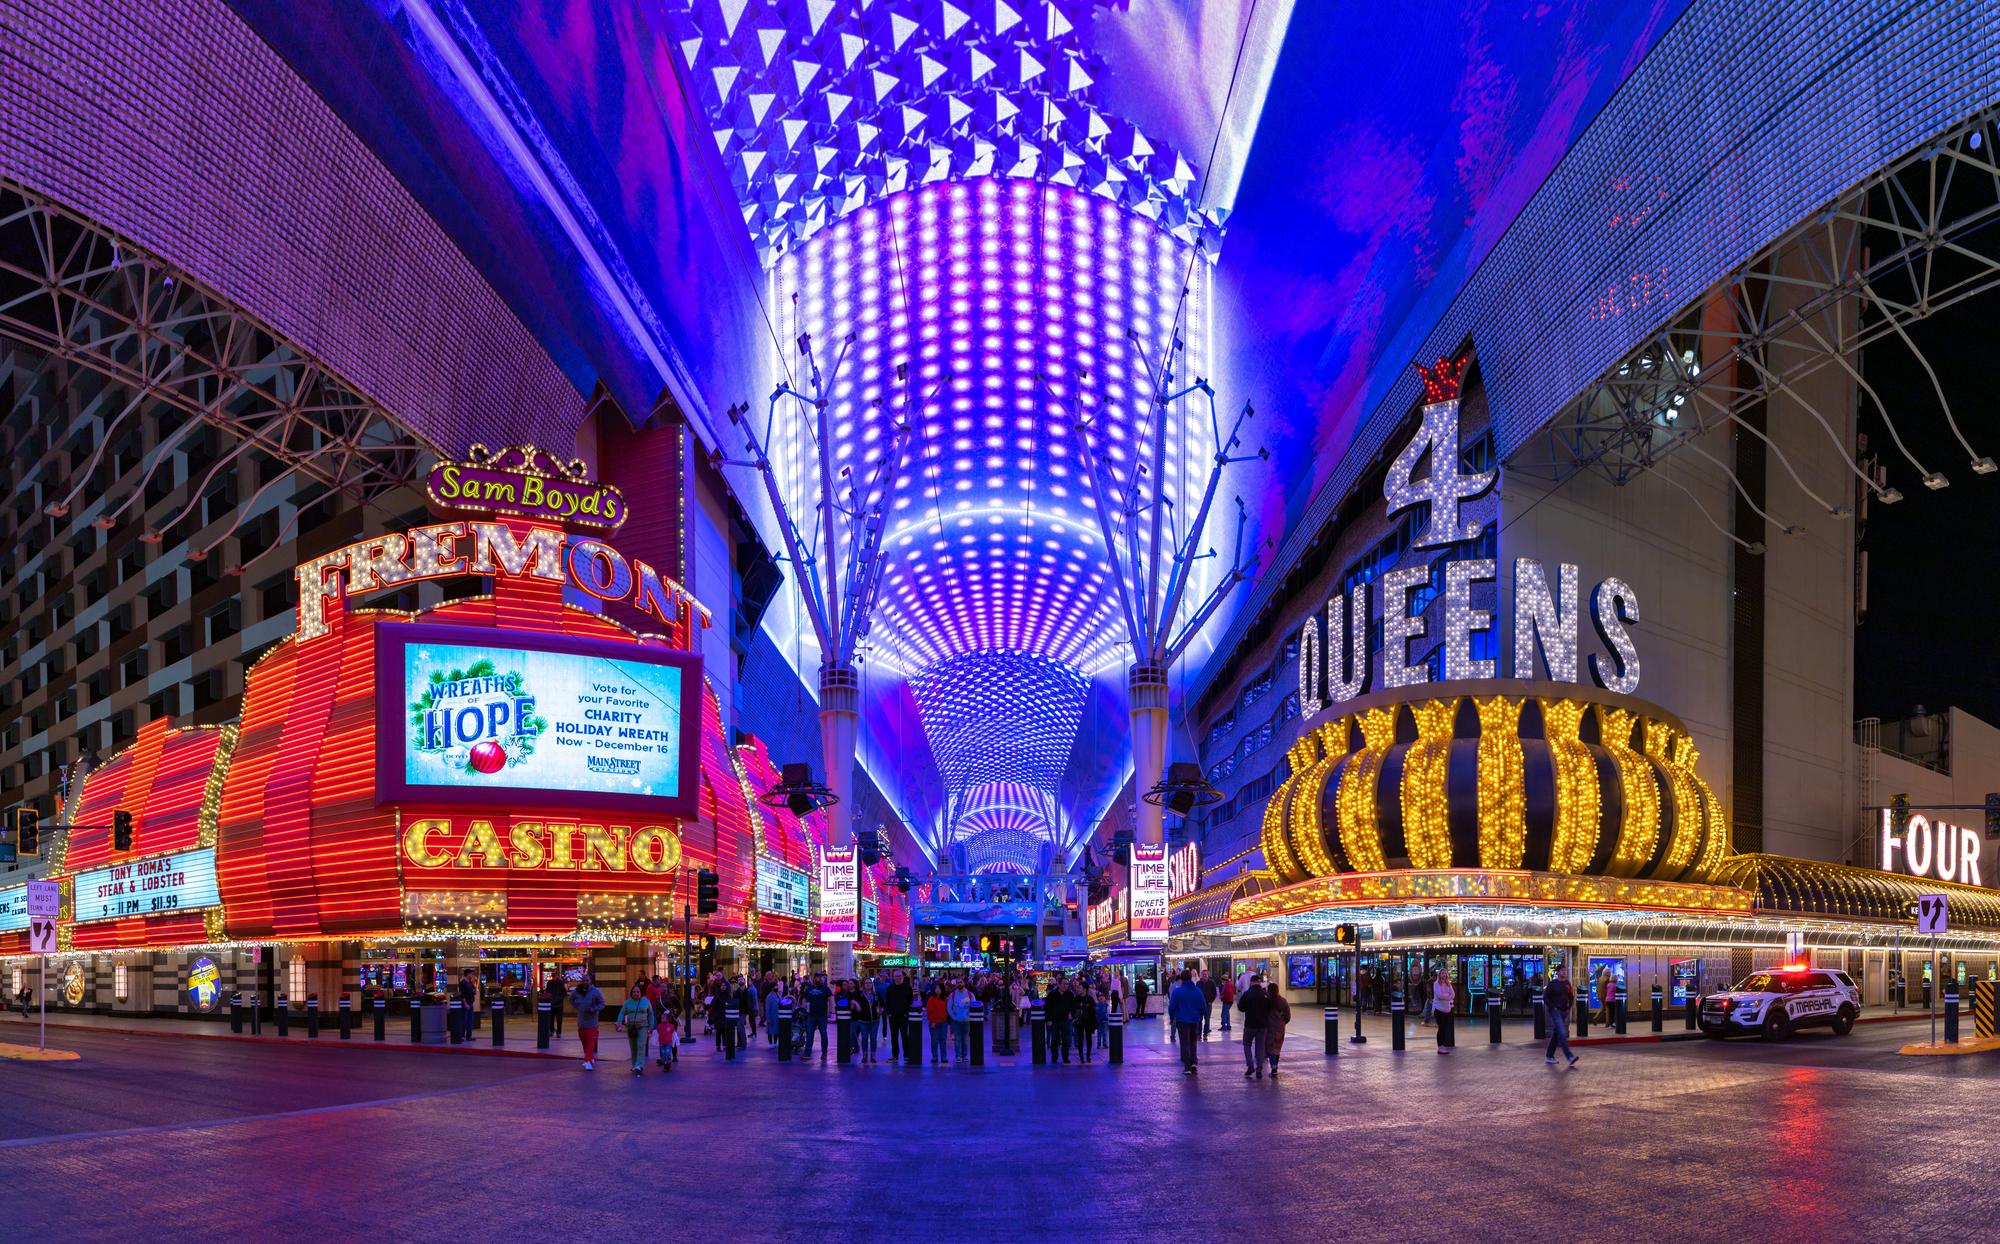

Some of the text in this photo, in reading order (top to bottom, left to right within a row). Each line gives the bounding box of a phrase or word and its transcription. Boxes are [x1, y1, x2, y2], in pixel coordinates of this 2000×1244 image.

[1383, 398, 1500, 551] 4
[440, 467, 617, 520] Sam Boyd's
[294, 521, 712, 653] FREMONT
[1299, 557, 1640, 721] QUEENS
[430, 675, 516, 699] WREATHS
[592, 683, 637, 695] Vote for
[578, 695, 650, 709] your Favorite
[422, 696, 537, 750] HOPE
[584, 709, 642, 724] CHARITY
[556, 722, 669, 742] HOLIDAY WREATH
[556, 736, 583, 746] Now
[595, 739, 653, 752] December
[657, 745, 669, 754] 16
[404, 818, 682, 874] CASINO
[1136, 850, 1162, 859] NYE
[826, 852, 852, 861] NYE
[110, 858, 171, 881] TONY ROMA'S
[98, 871, 185, 898] STEAK & LOBSTER
[35, 894, 52, 902] MUST
[102, 904, 108, 917] 9
[127, 899, 139, 914] PM
[151, 894, 178, 911] $11.99
[1134, 899, 1165, 908] TICKETS
[838, 907, 855, 915] TEAM
[1134, 908, 1166, 917] ON SALE
[1140, 919, 1163, 929] NOW
[1796, 998, 1837, 1014] MARSHAL
